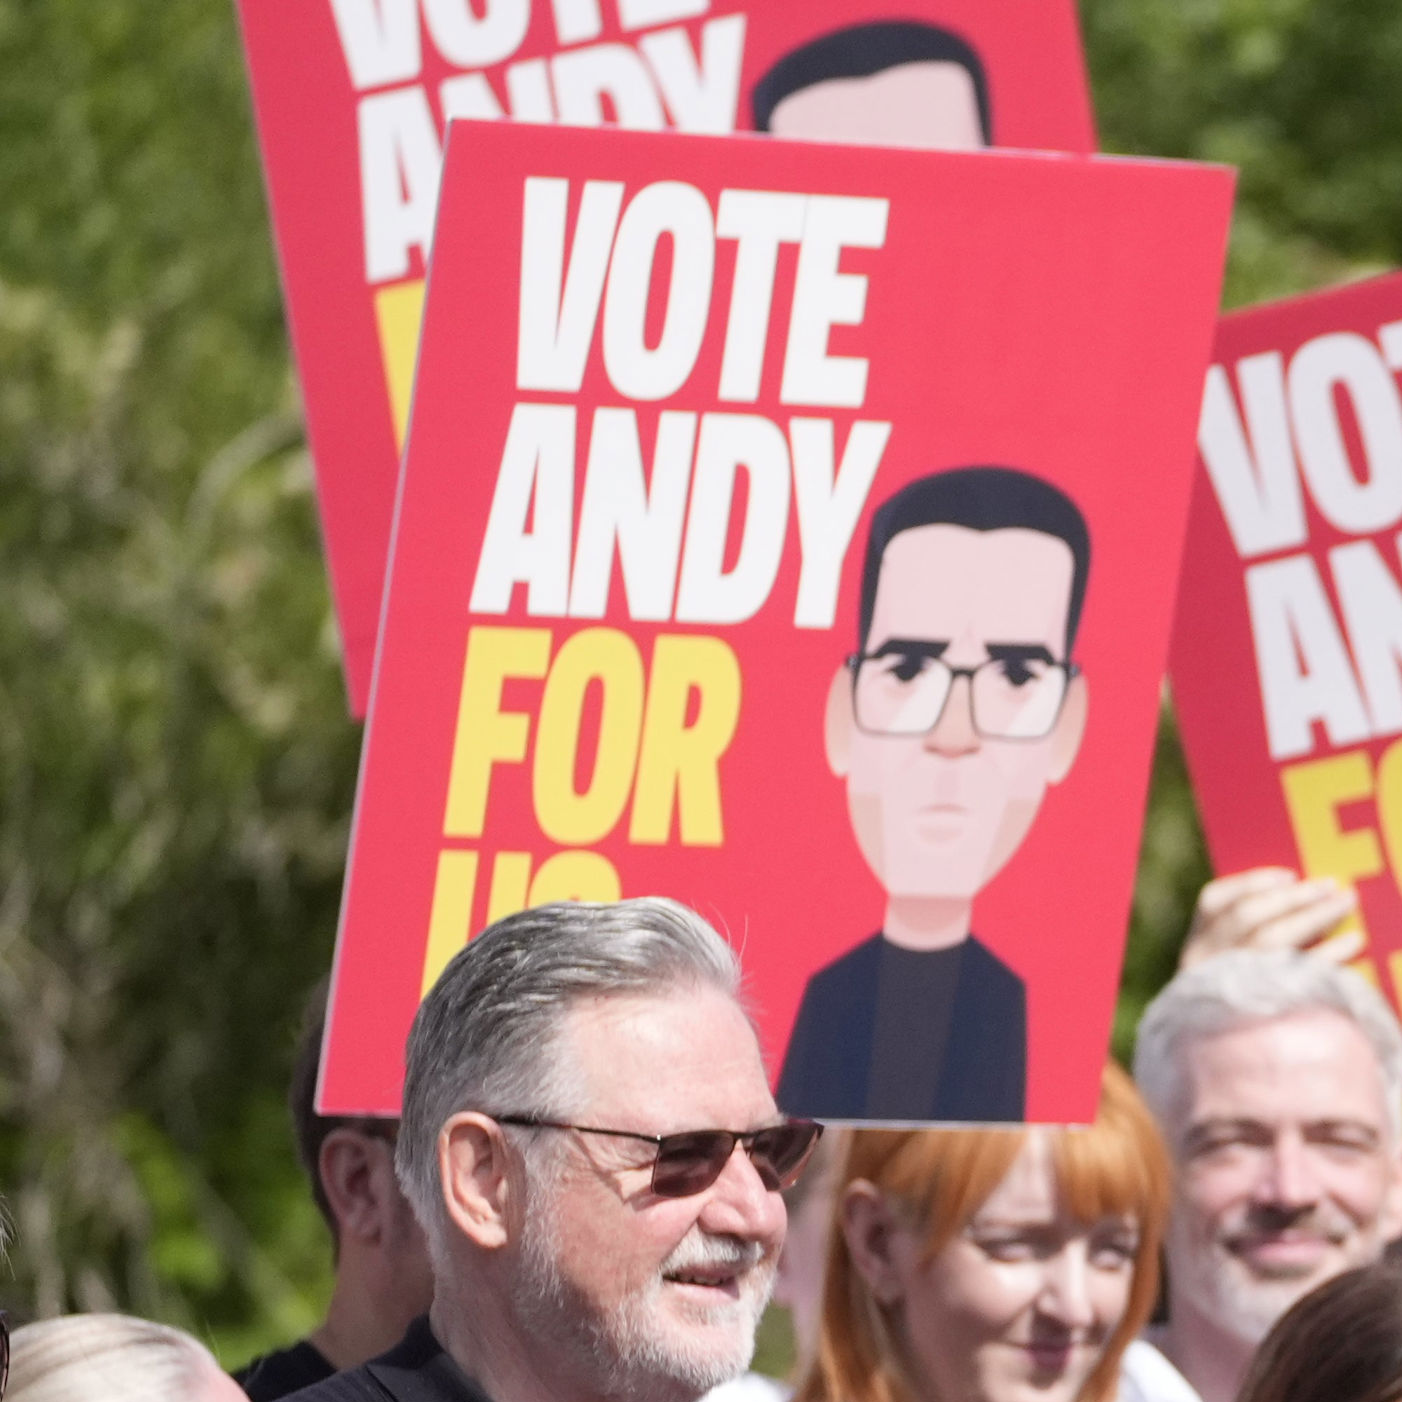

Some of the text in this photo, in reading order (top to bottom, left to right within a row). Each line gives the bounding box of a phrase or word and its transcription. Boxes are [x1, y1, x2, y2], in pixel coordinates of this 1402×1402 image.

[516, 176, 890, 408] VOTE
[467, 402, 892, 629] ANDY
[443, 626, 741, 847] FOR
